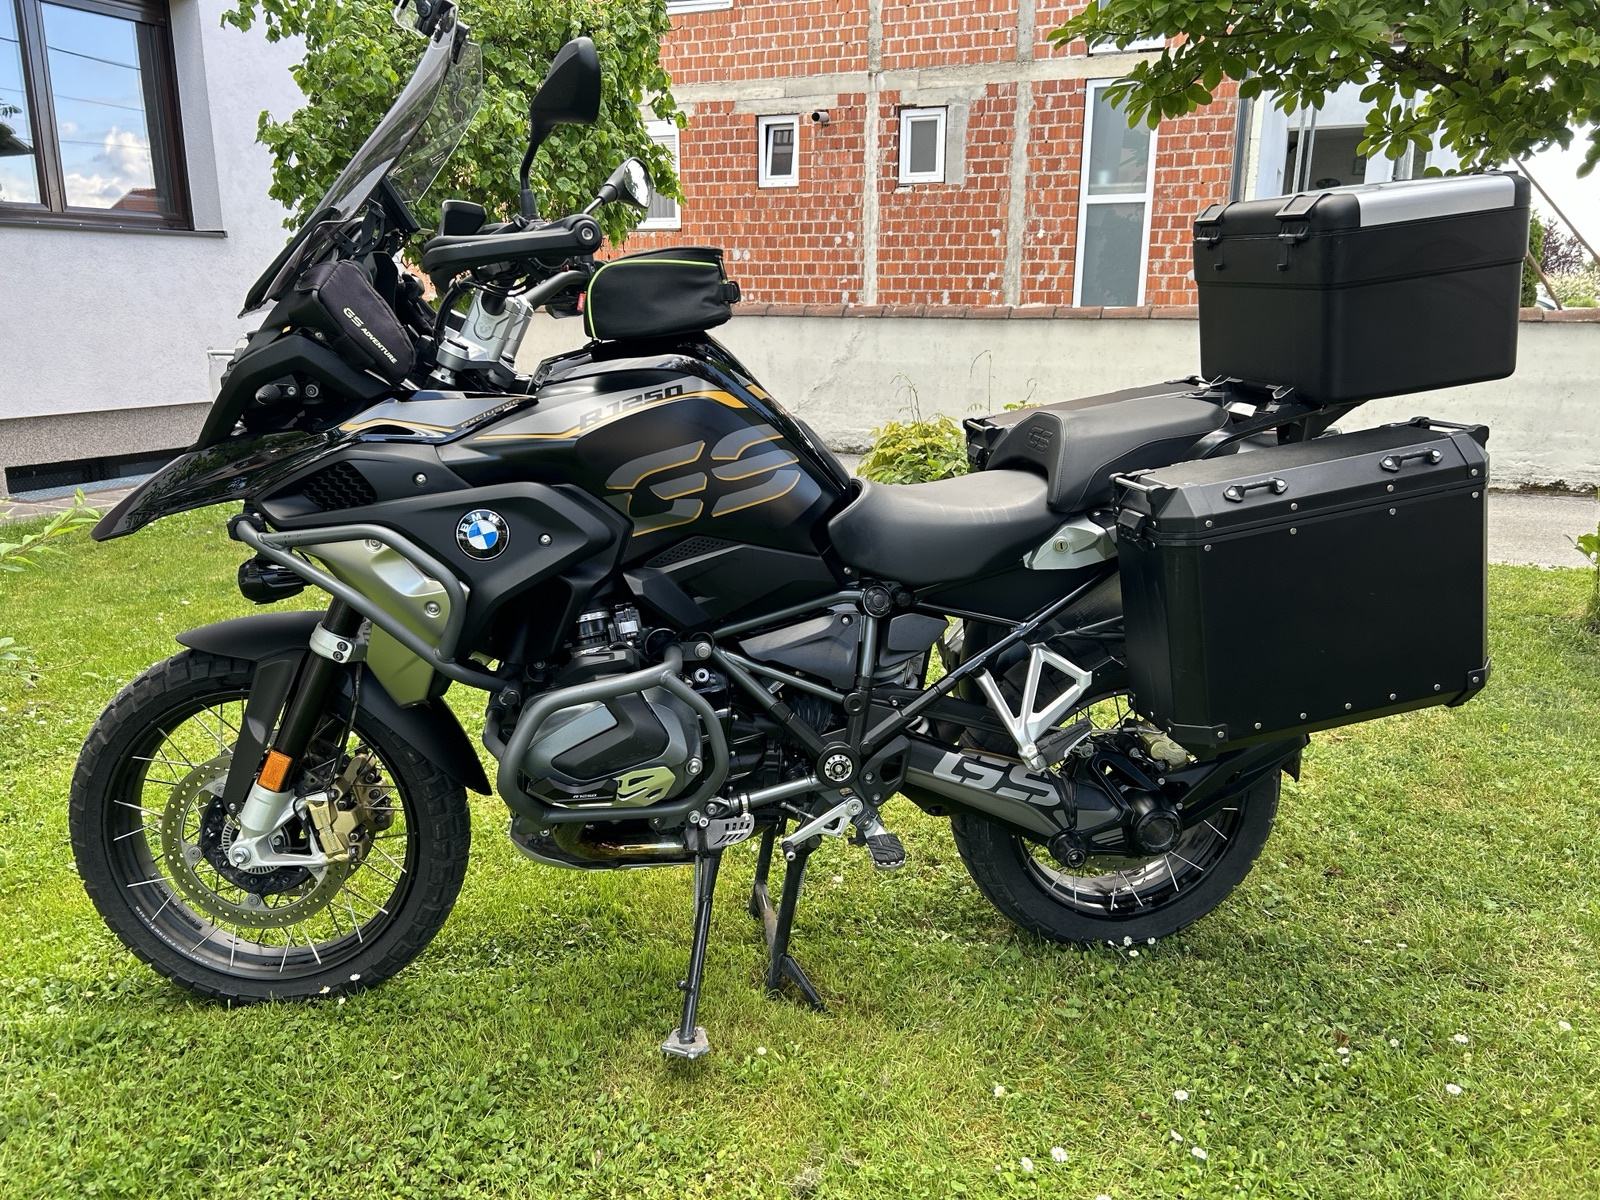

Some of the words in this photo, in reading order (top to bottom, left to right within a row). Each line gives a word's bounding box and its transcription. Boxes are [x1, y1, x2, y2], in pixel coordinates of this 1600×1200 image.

[343, 307, 365, 328] GS
[361, 328, 398, 364] ADVENTURE
[580, 385, 684, 428] R1250
[603, 424, 801, 537] GS
[459, 512, 500, 532] BMW
[933, 751, 1061, 807] GS
